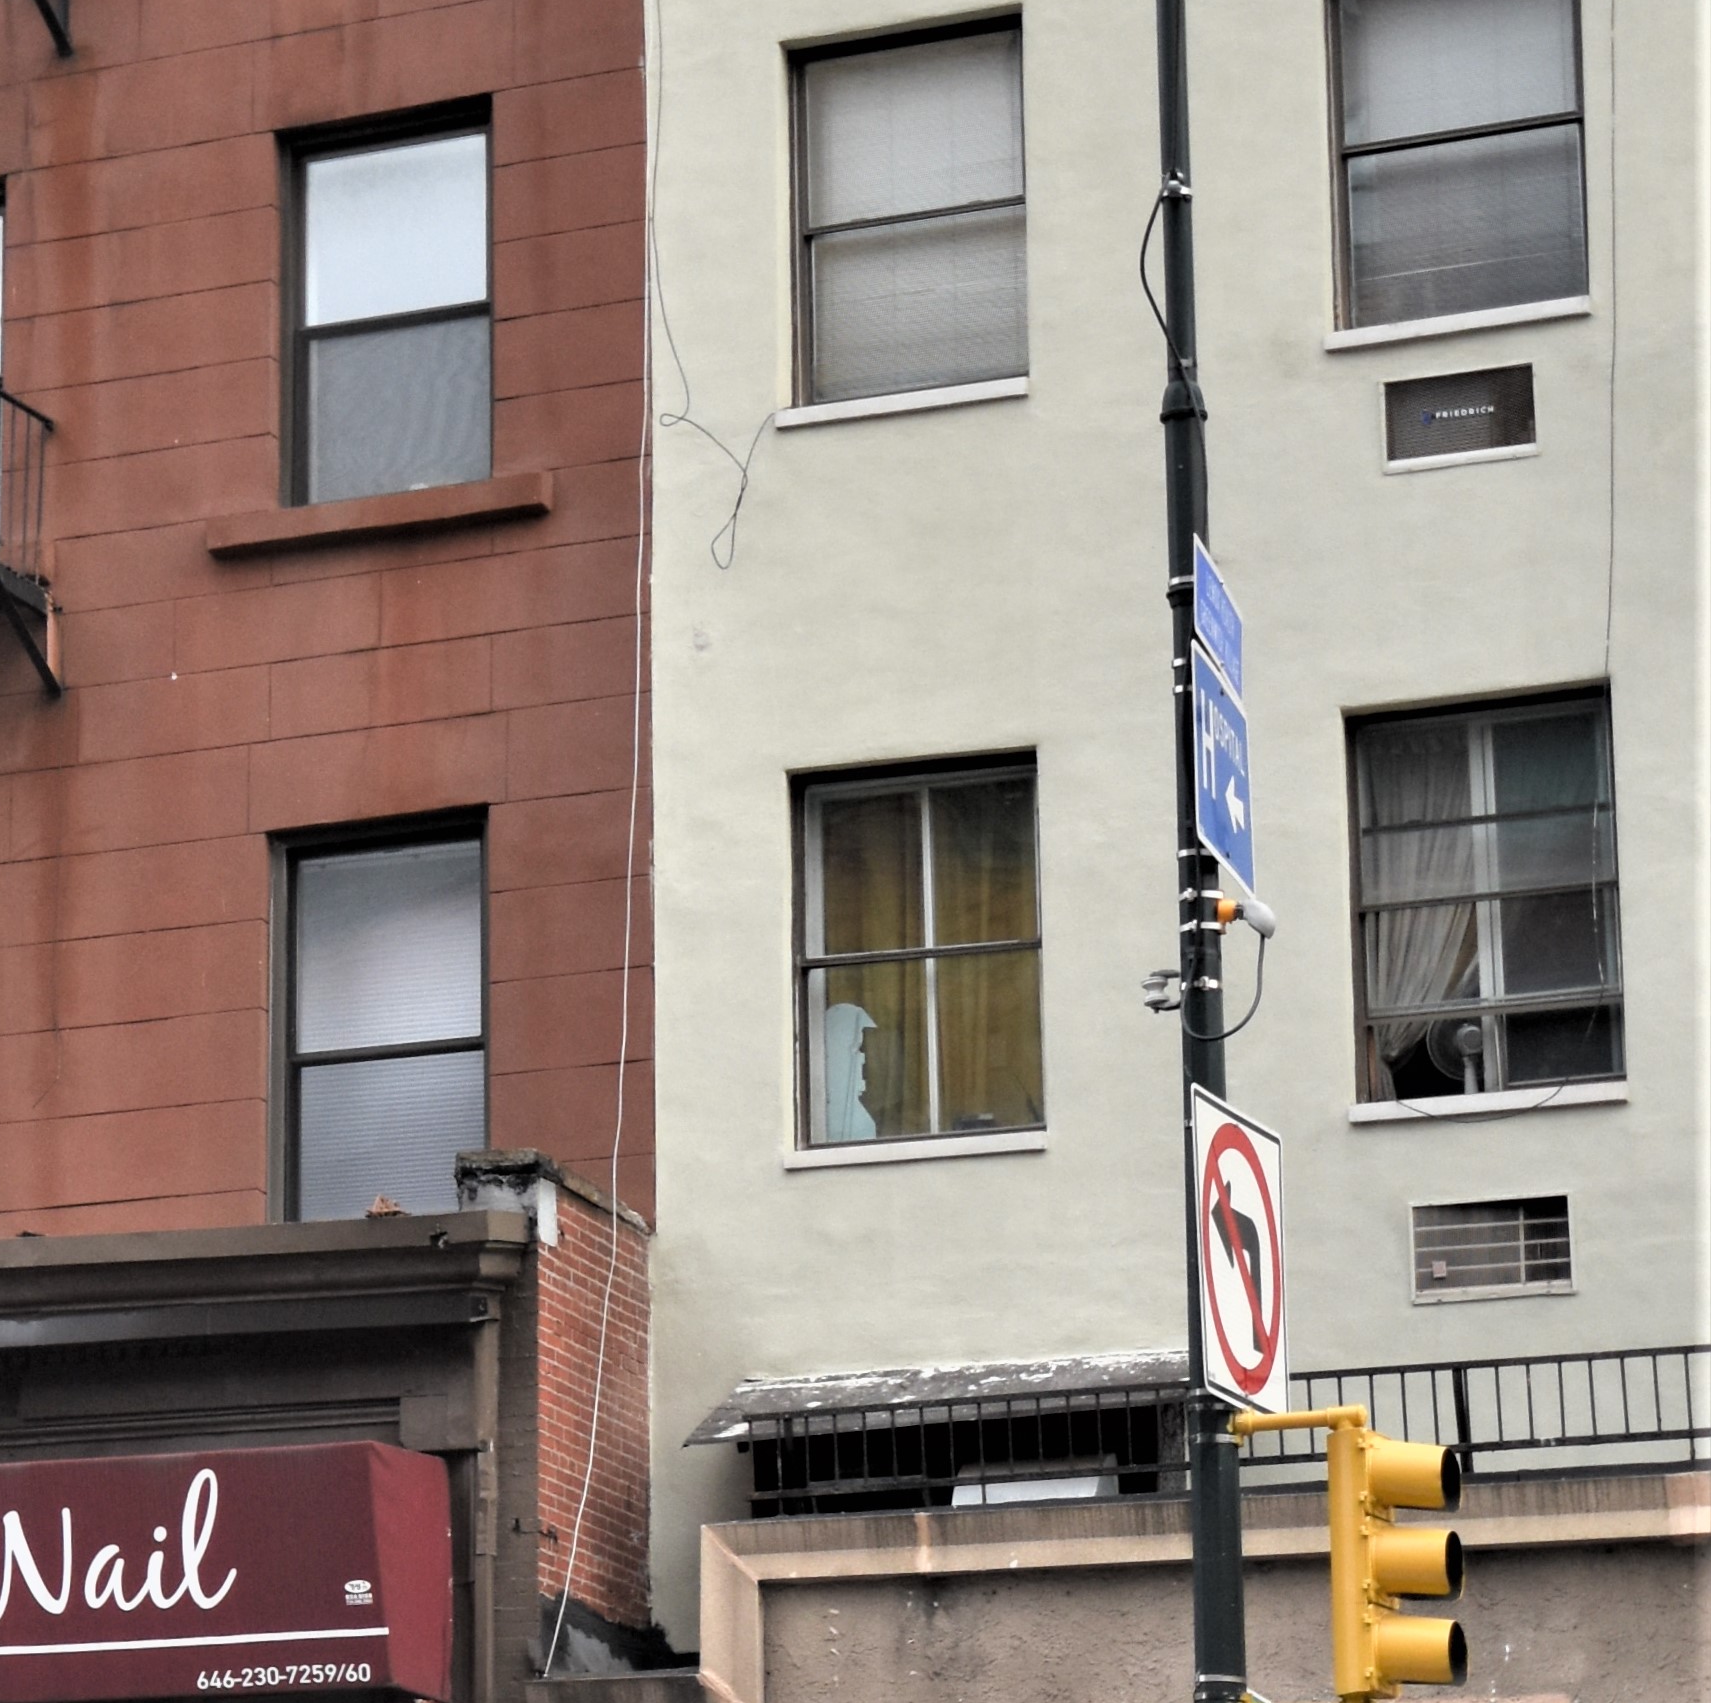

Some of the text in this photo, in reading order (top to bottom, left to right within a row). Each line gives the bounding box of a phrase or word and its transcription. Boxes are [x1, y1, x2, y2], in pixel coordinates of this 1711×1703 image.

[1435, 405, 1494, 419] FRIEDRICH
[1200, 687, 1246, 800] HOSPITAL
[196, 1662, 371, 1691] 646-230-7259/60
